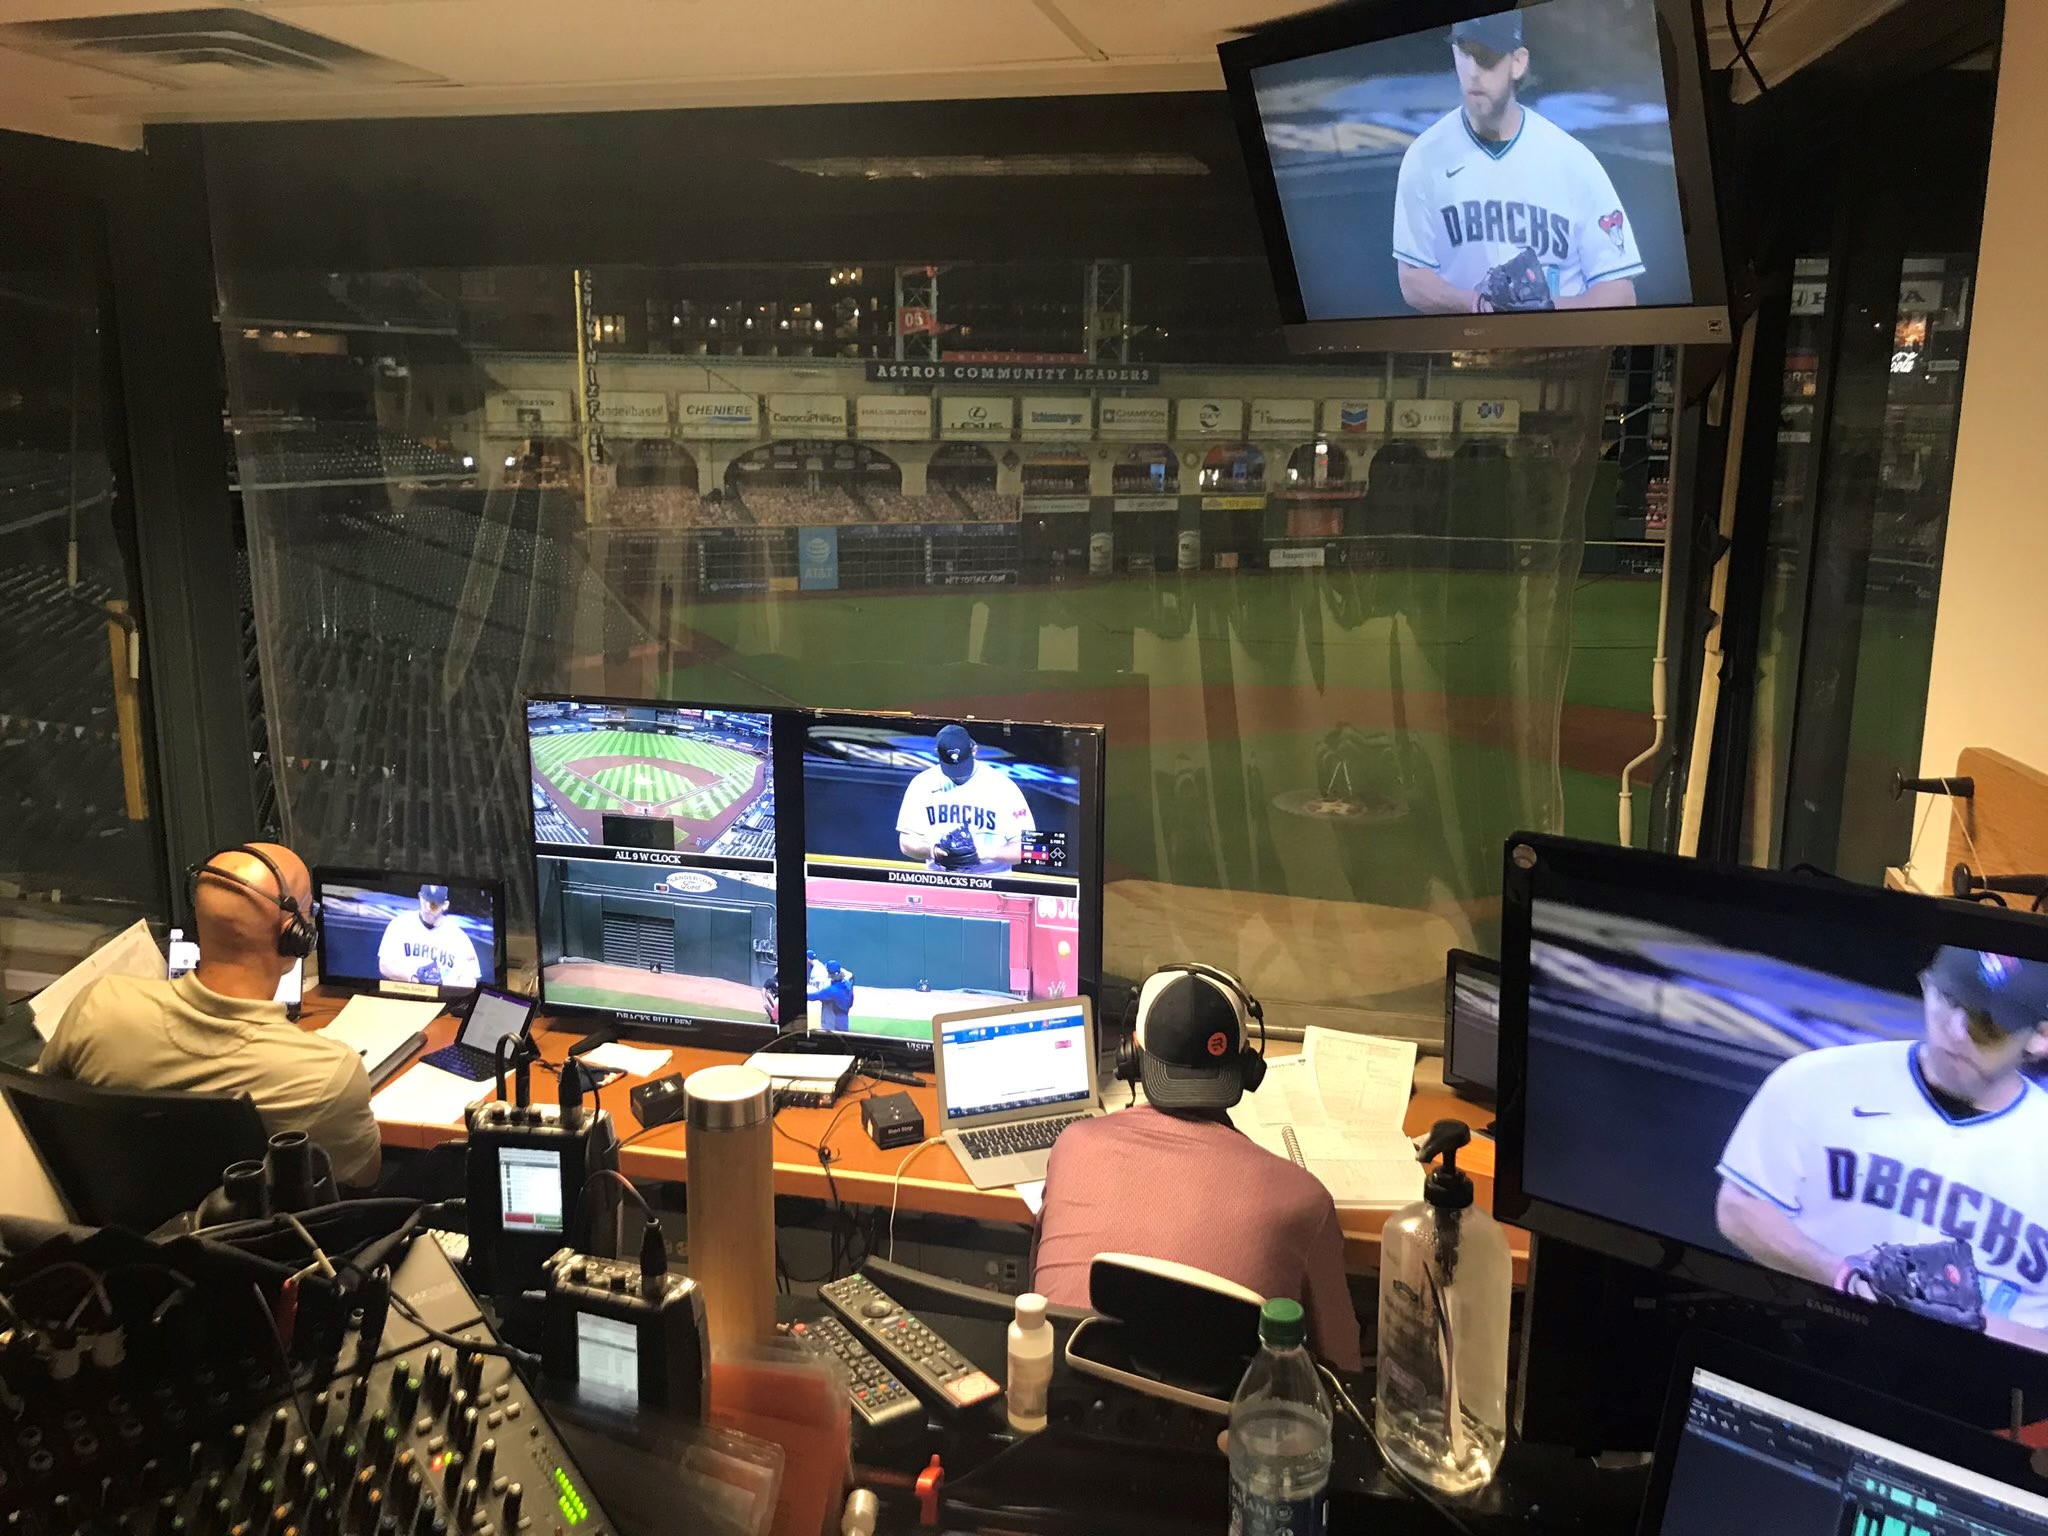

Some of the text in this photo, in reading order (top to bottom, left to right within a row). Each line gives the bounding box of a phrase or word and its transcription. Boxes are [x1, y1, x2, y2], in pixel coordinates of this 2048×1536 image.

[1440, 200, 1570, 261] DBACKS
[904, 312, 924, 328] 05
[876, 366, 1150, 382] ASTROS COMMUNITY LEADERS
[686, 404, 753, 416] CHENIERE
[772, 411, 843, 424] ConocoPhillips
[951, 421, 1004, 430] LEXUS
[804, 567, 833, 579] AT&T
[926, 804, 997, 830] DBACKS
[615, 851, 682, 864] ALL 9 W CLOCK
[888, 872, 993, 889] DIAMONDBACKS PGM
[404, 942, 455, 968] DBACKS
[906, 1041, 931, 1051] VISIT
[1823, 1146, 2048, 1283] DBACKS
[1806, 1299, 1870, 1326] SAMSUNG
